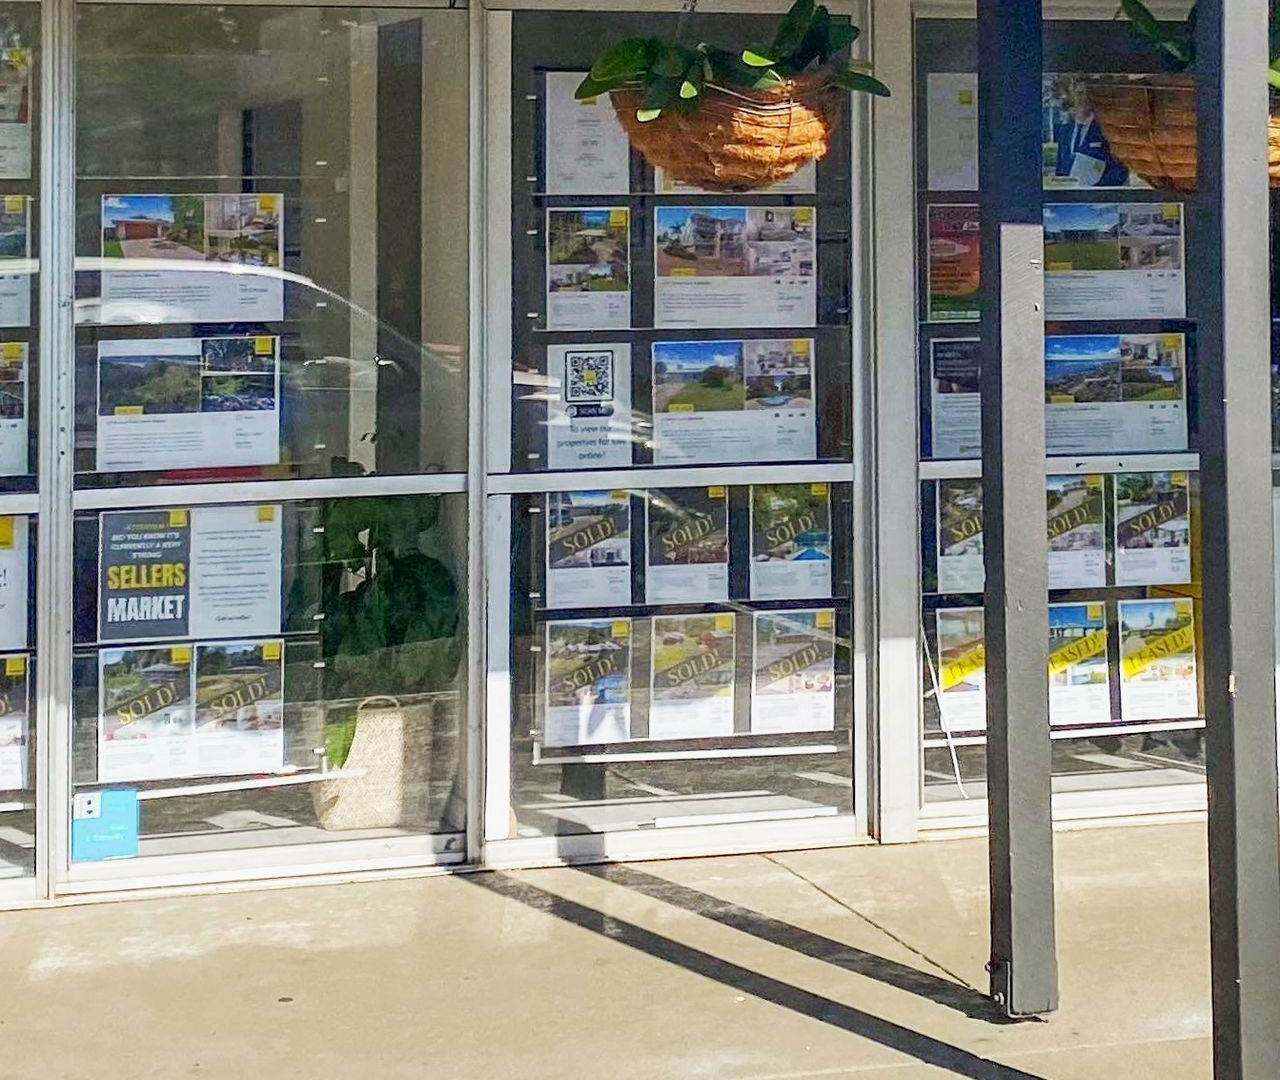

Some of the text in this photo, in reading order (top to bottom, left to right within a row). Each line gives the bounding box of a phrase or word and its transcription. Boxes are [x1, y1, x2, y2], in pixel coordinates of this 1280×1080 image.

[662, 517, 716, 551] SOLD!
[767, 511, 818, 548] SOLD!
[1130, 499, 1177, 533] SOLD!
[562, 517, 619, 553] SOLD!
[107, 563, 186, 590] SELLERS
[107, 595, 186, 623] MARKET
[563, 654, 618, 690] SOLD!
[667, 648, 722, 686] SOLD!
[769, 644, 822, 682] SOLD!
[117, 682, 179, 725] SOLD!
[210, 677, 269, 718] SOLD!
